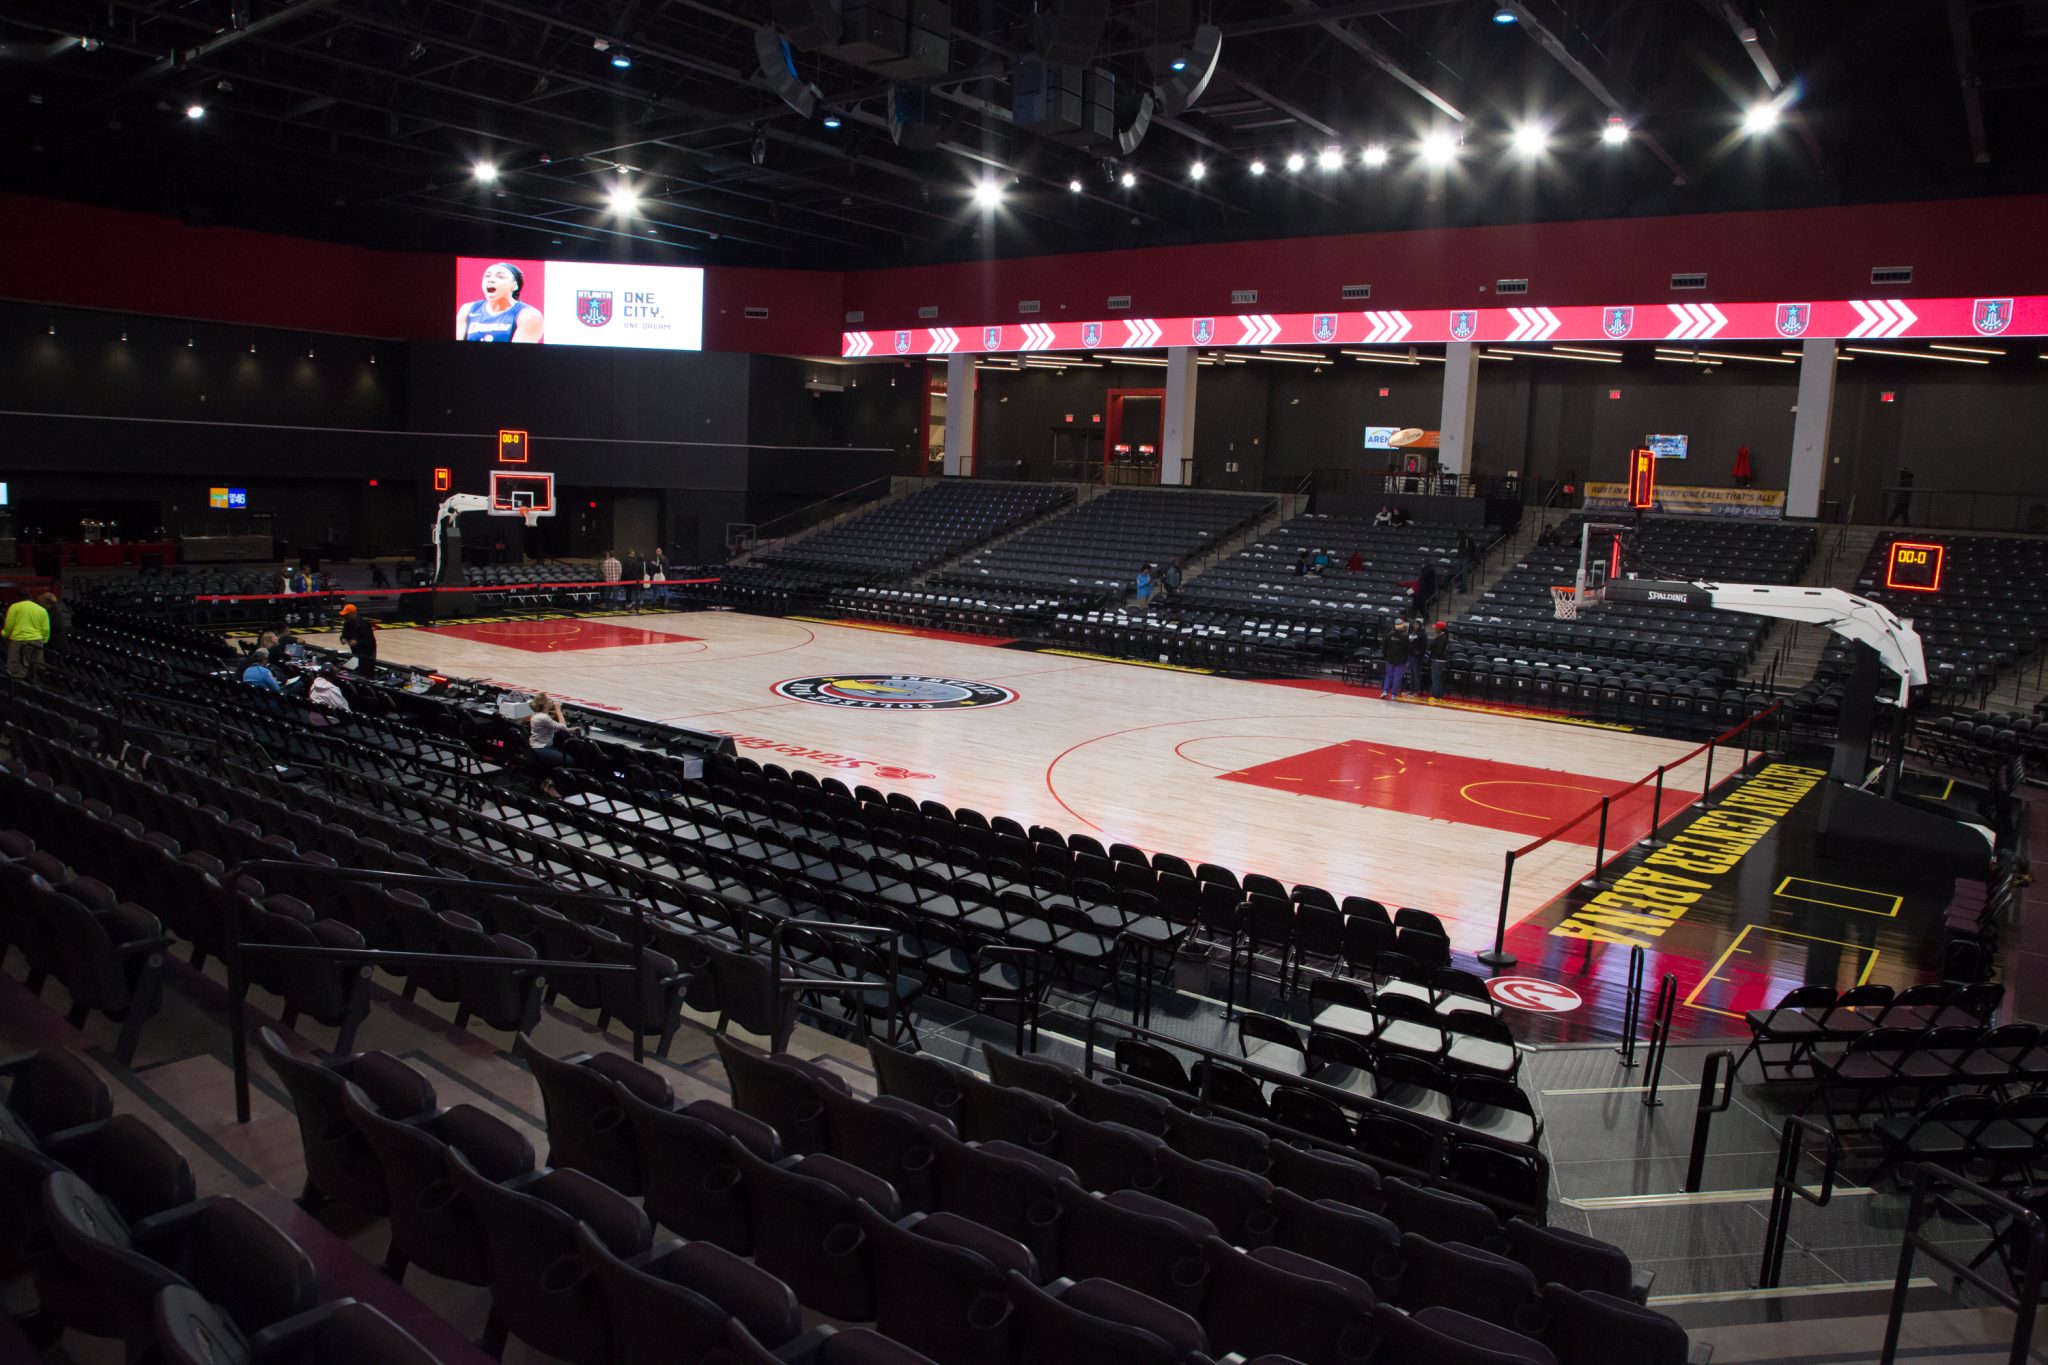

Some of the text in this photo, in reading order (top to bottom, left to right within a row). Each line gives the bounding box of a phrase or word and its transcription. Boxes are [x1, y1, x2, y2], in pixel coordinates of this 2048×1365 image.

[578, 291, 612, 299] ATLANTA
[624, 291, 655, 304] ONE
[624, 306, 664, 319] CITY.
[1591, 486, 1613, 494] HURT
[1682, 490, 1699, 498] ONE
[1725, 493, 1754, 501] THAT'S
[1756, 494, 1776, 502] ALL!
[1647, 591, 1688, 603] SPALDING
[1547, 763, 1829, 949] GATEWAY CENTER ARENA
